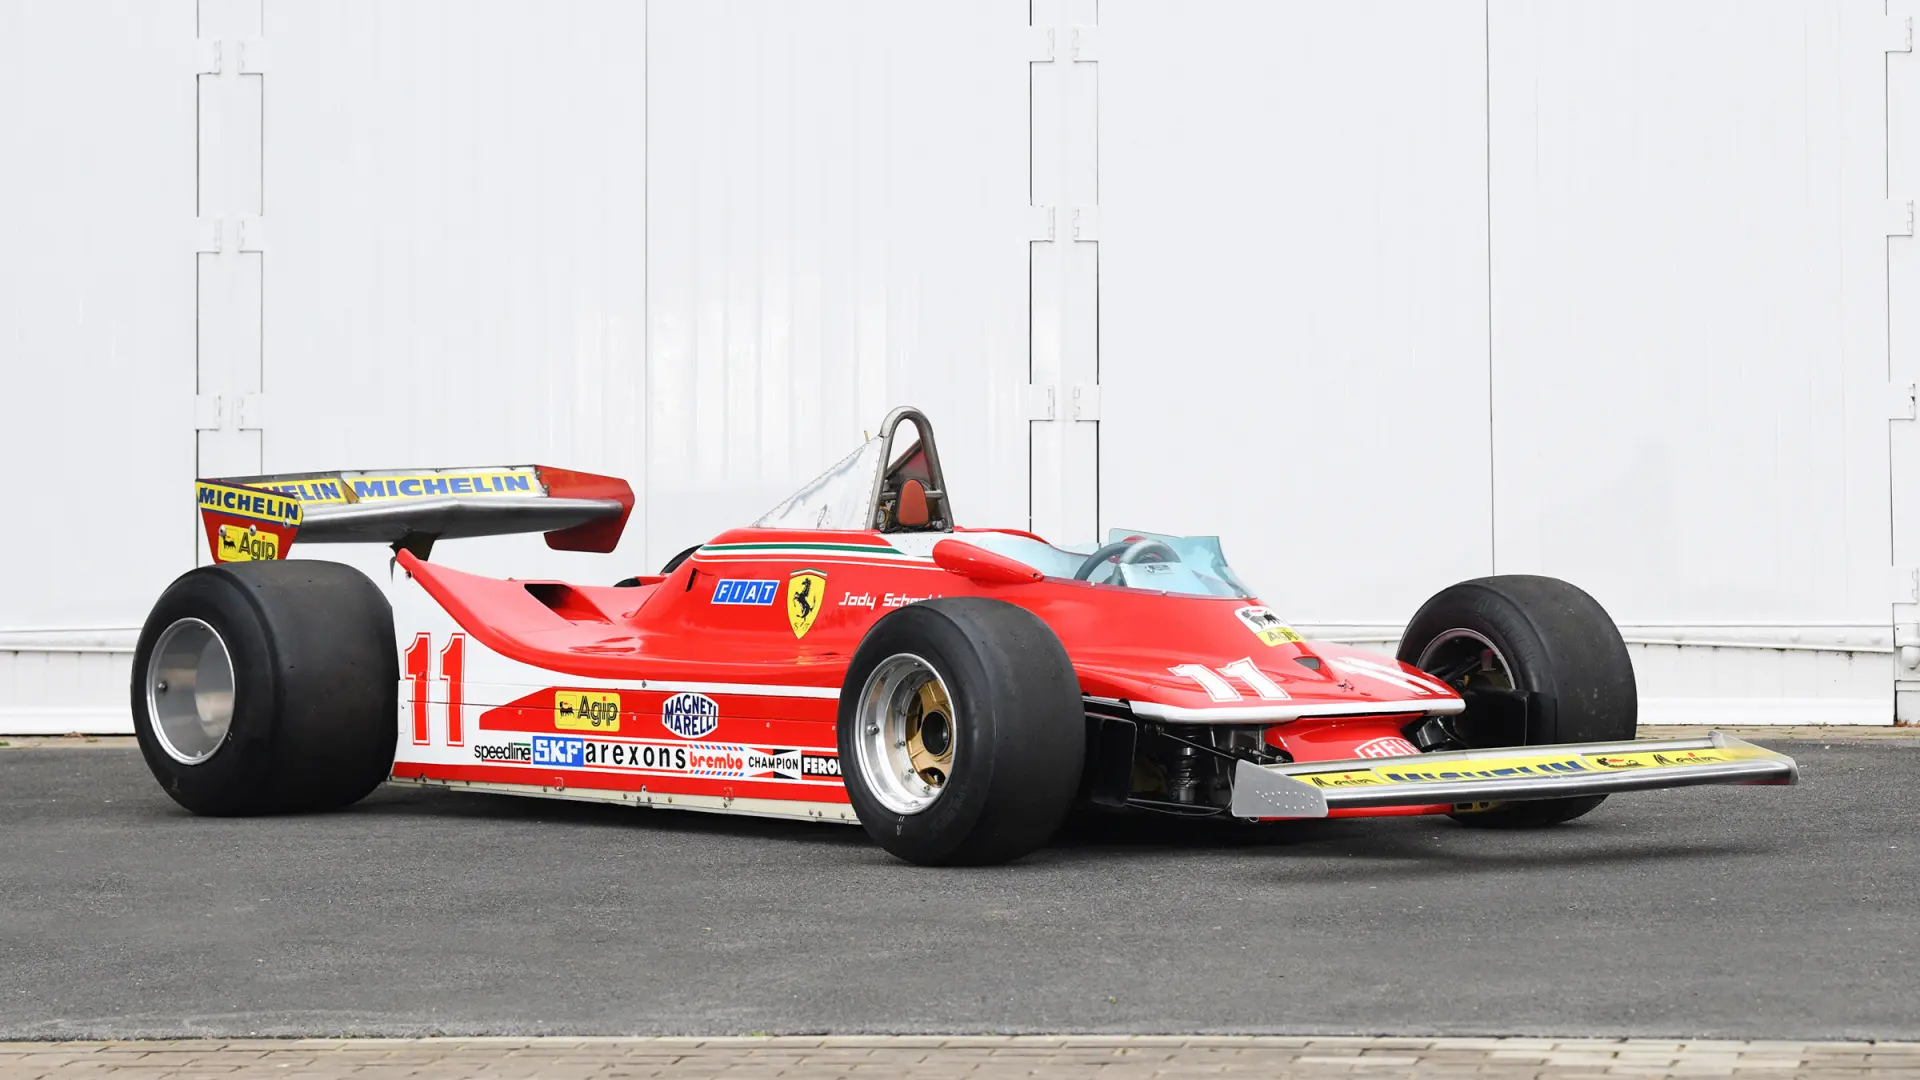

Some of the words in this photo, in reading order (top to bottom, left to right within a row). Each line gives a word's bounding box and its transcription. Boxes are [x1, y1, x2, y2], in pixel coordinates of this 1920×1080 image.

[353, 474, 531, 498] MICHELIN
[200, 486, 299, 521] MICHELIN
[238, 531, 276, 562] Agip
[717, 583, 776, 601] FIAT
[404, 632, 466, 748] 11
[1166, 656, 1293, 703] 11
[576, 694, 618, 727] Agip
[664, 694, 718, 717] MAGNETI
[664, 714, 717, 737] MARELLI
[474, 741, 531, 762] speedline
[534, 738, 582, 765] SKF
[585, 742, 687, 769] arexons
[689, 751, 744, 770] brembo
[748, 755, 799, 771] CHAMPION
